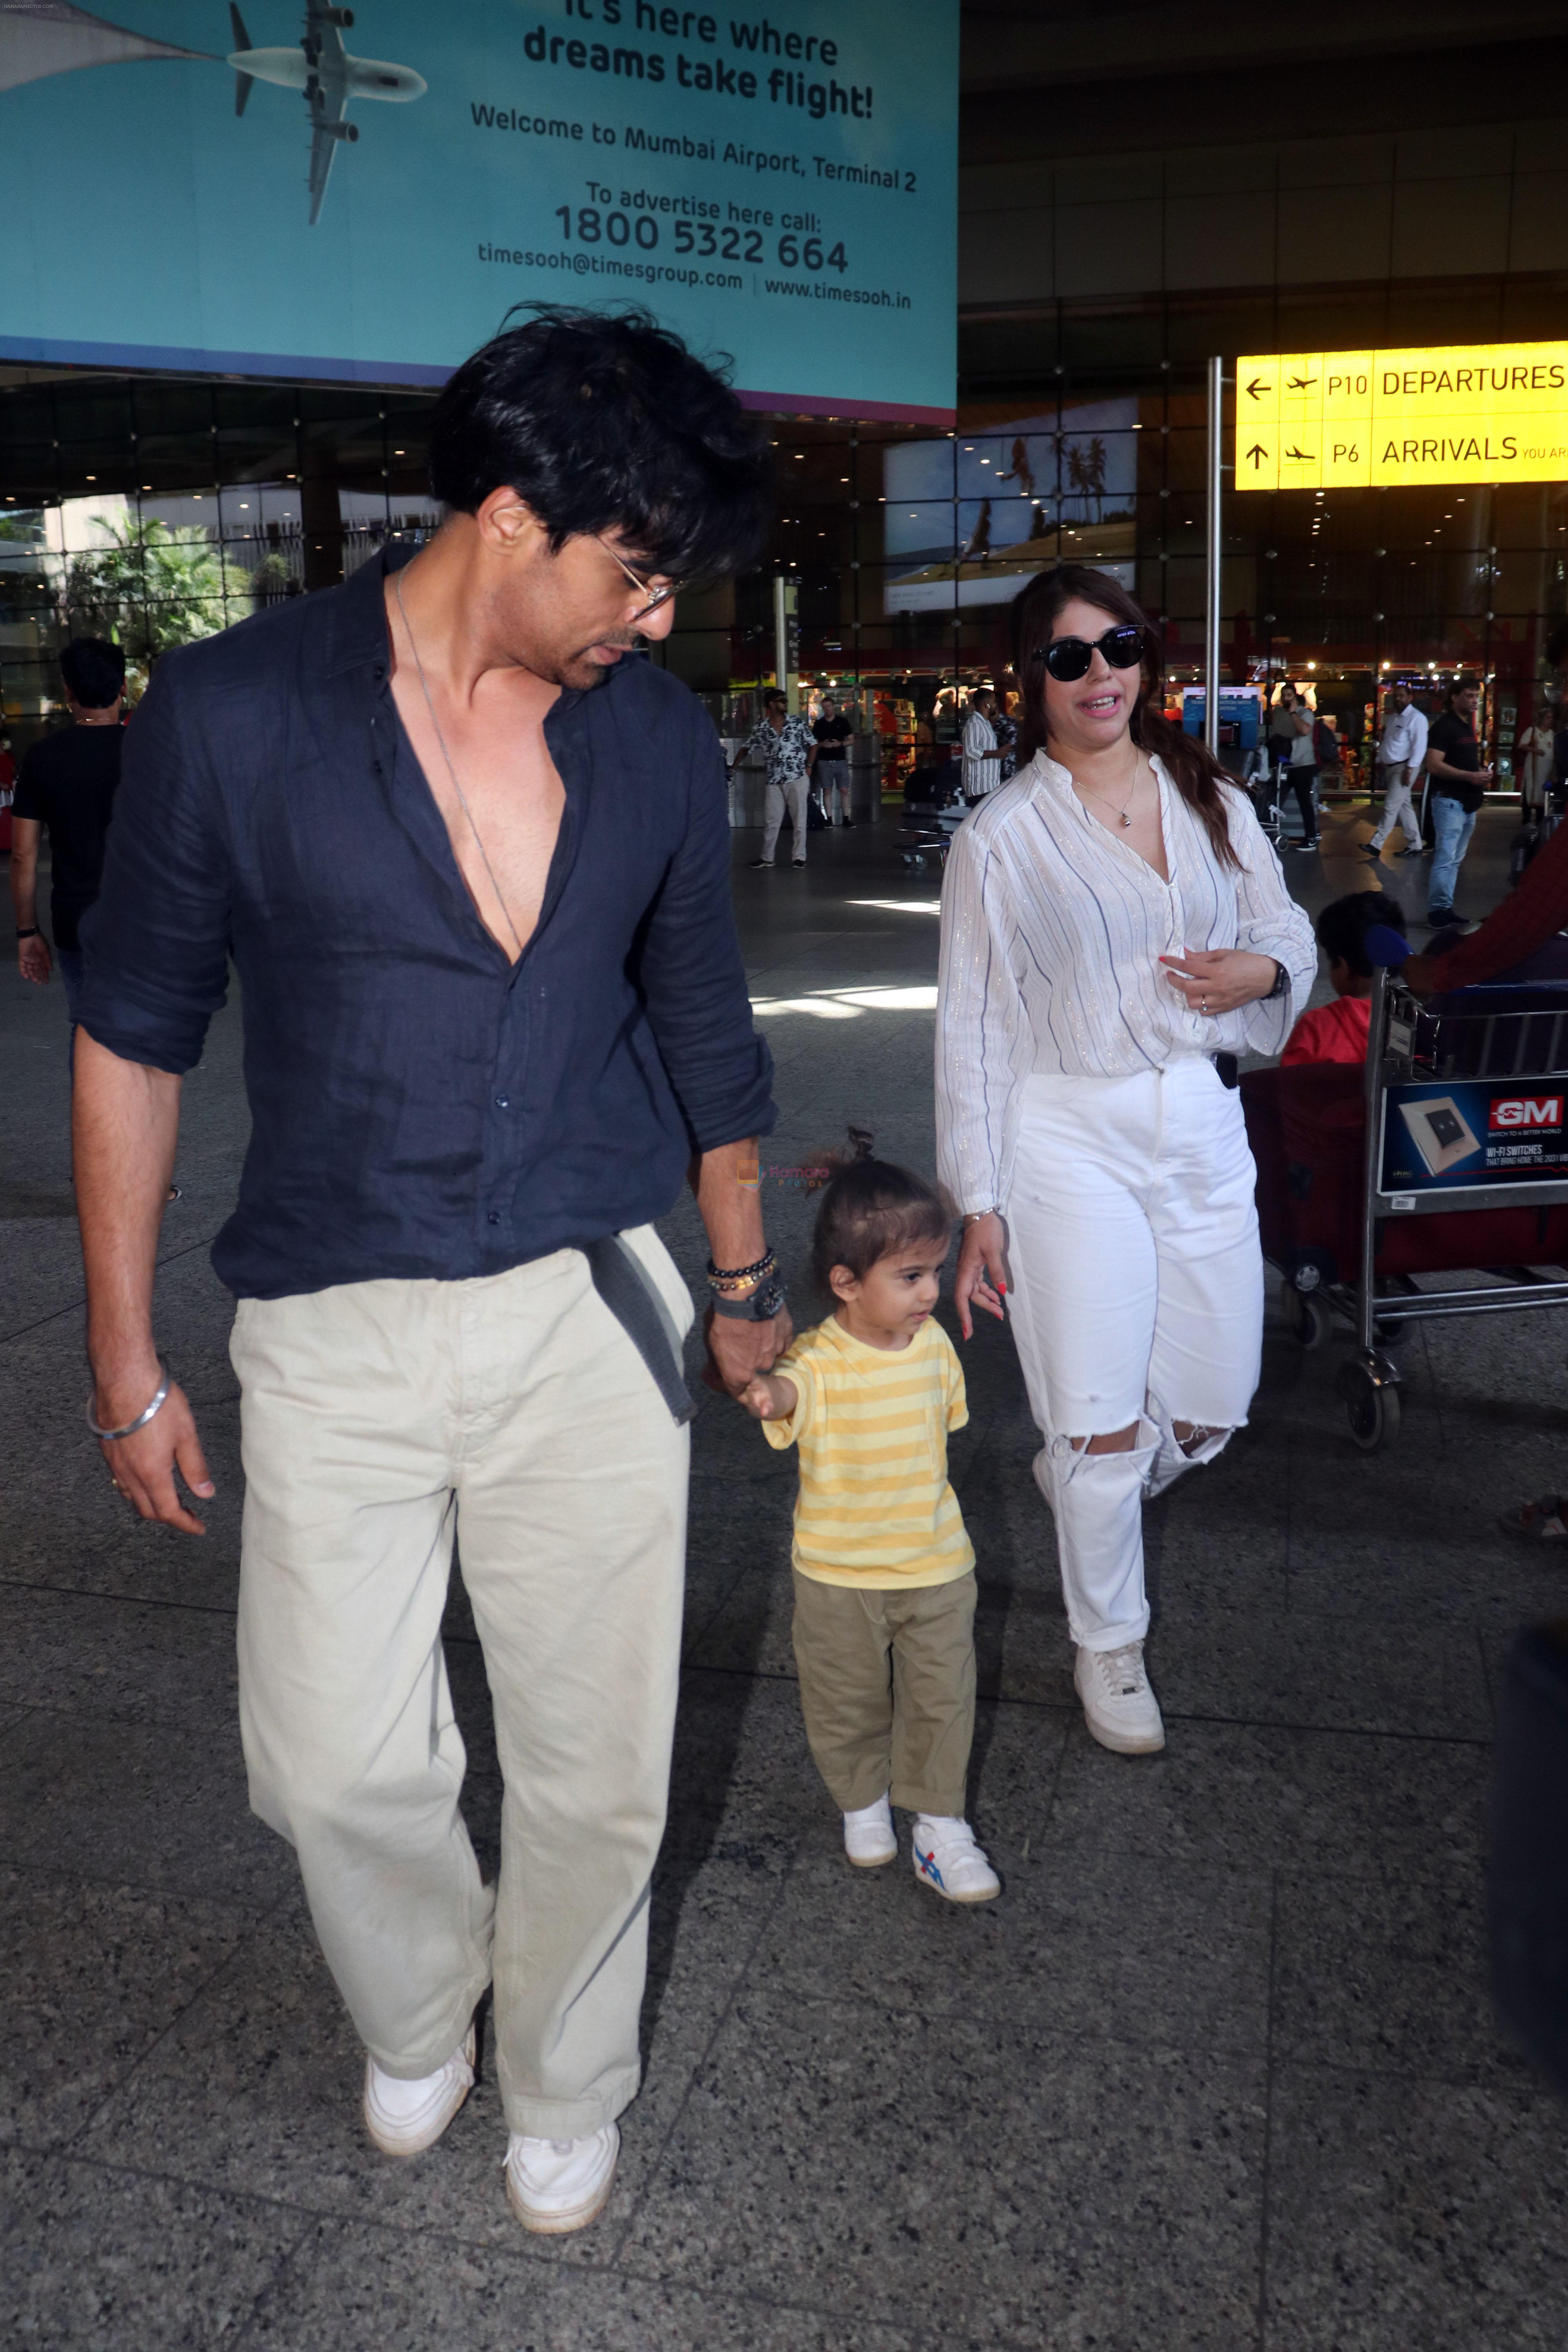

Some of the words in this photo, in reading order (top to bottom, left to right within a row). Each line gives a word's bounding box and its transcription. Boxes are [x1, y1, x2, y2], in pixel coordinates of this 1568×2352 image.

[636, 0, 717, 43] here
[730, 19, 838, 66] where
[524, 25, 665, 83] dreams
[677, 54, 757, 99] take
[768, 69, 873, 120] flight!
[470, 102, 583, 141] Welcome
[592, 123, 616, 146] to
[625, 127, 715, 161] Mumbai
[723, 143, 806, 178] Airport,
[813, 156, 899, 189] Terminal
[904, 171, 916, 193] 2
[585, 181, 612, 204] To
[620, 191, 720, 219] advertise
[728, 201, 774, 227] here
[781, 212, 821, 232] call:
[555, 205, 659, 250] 1800
[675, 220, 764, 264] 5322
[778, 235, 849, 274] 664
[477, 243, 743, 289] timesooh@timesgroup.com
[764, 278, 911, 310] www.timesooh.in
[1328, 375, 1367, 395] P10
[1383, 365, 1565, 395] DEPARTURES
[1333, 444, 1359, 463] P6
[1382, 437, 1518, 463] ARRIVALS
[1522, 448, 1546, 459] YOU
[1549, 447, 1568, 458] AR
[1496, 1100, 1559, 1125] GM
[1486, 1146, 1505, 1158] WI-FI
[1506, 1144, 1543, 1156] SWITCHES
[1486, 1158, 1499, 1167] THAT
[1500, 1157, 1517, 1166] BRING
[1517, 1156, 1532, 1164] HOME
[1534, 1155, 1543, 1163] THE
[1545, 1154, 1558, 1163] 2031
